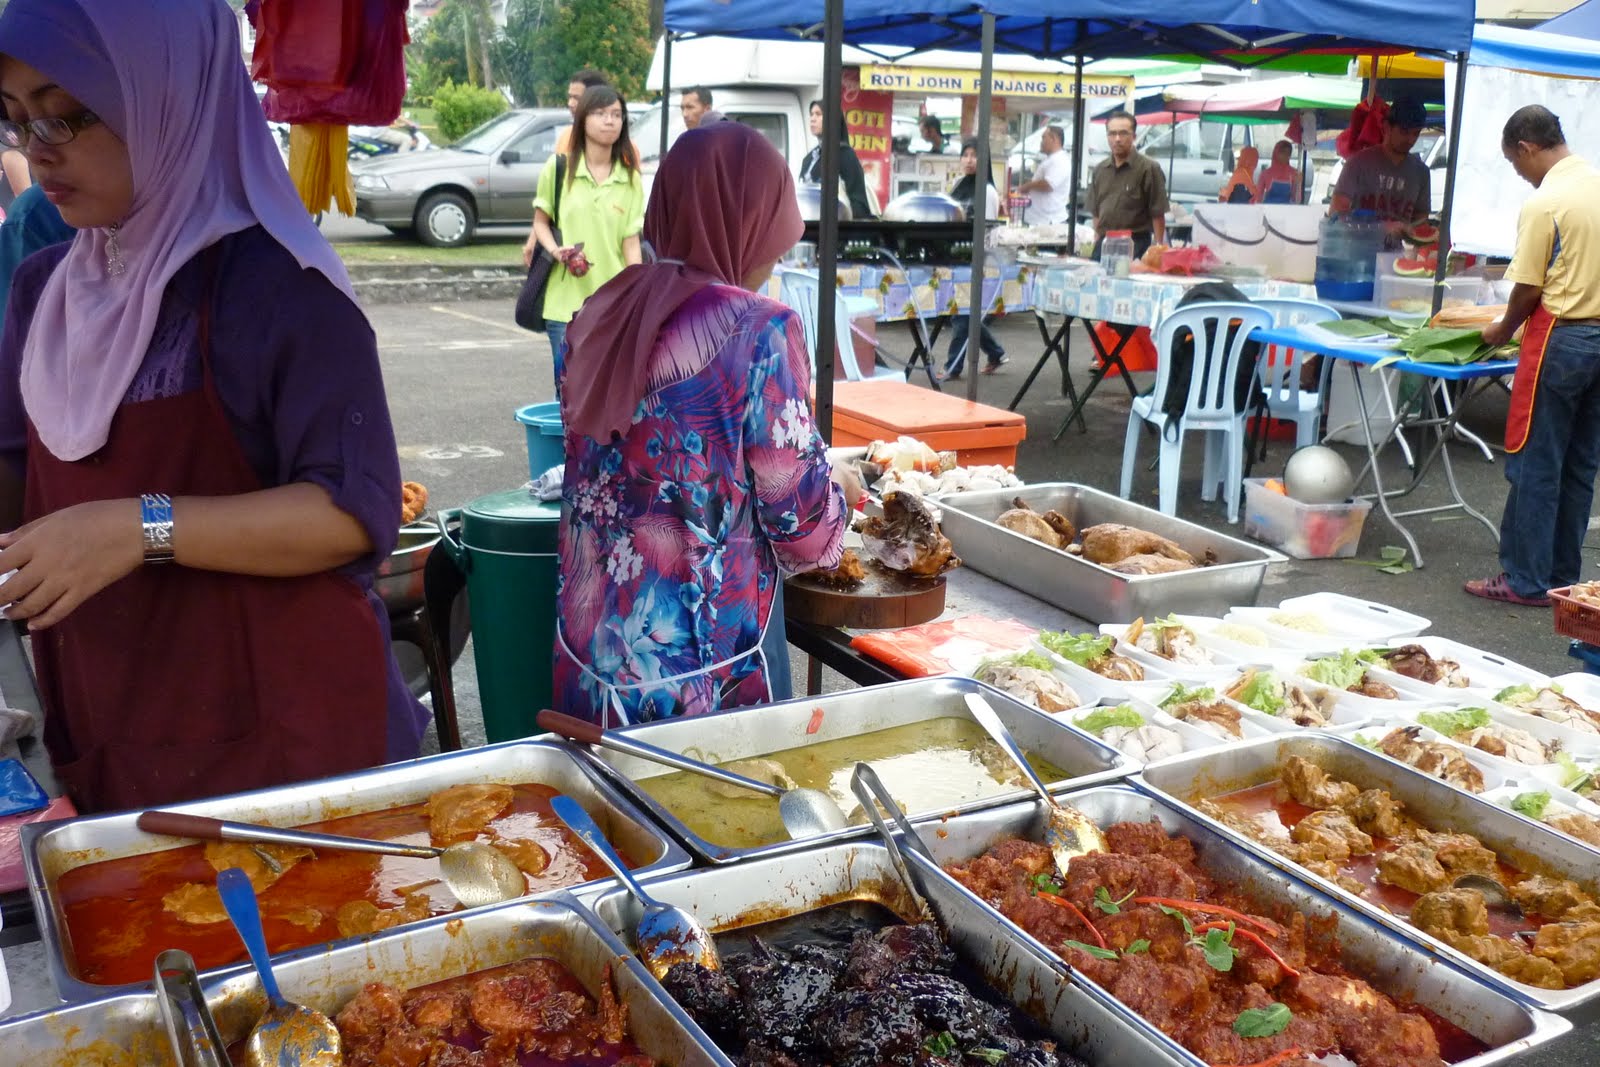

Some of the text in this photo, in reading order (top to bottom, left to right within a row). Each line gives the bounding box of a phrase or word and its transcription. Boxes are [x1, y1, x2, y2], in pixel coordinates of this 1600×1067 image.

[871, 74, 910, 87] ROTI
[917, 77, 961, 89] JOHN
[974, 79, 1047, 93] PNJANG
[1053, 83, 1062, 93] &
[847, 109, 884, 128] OTI
